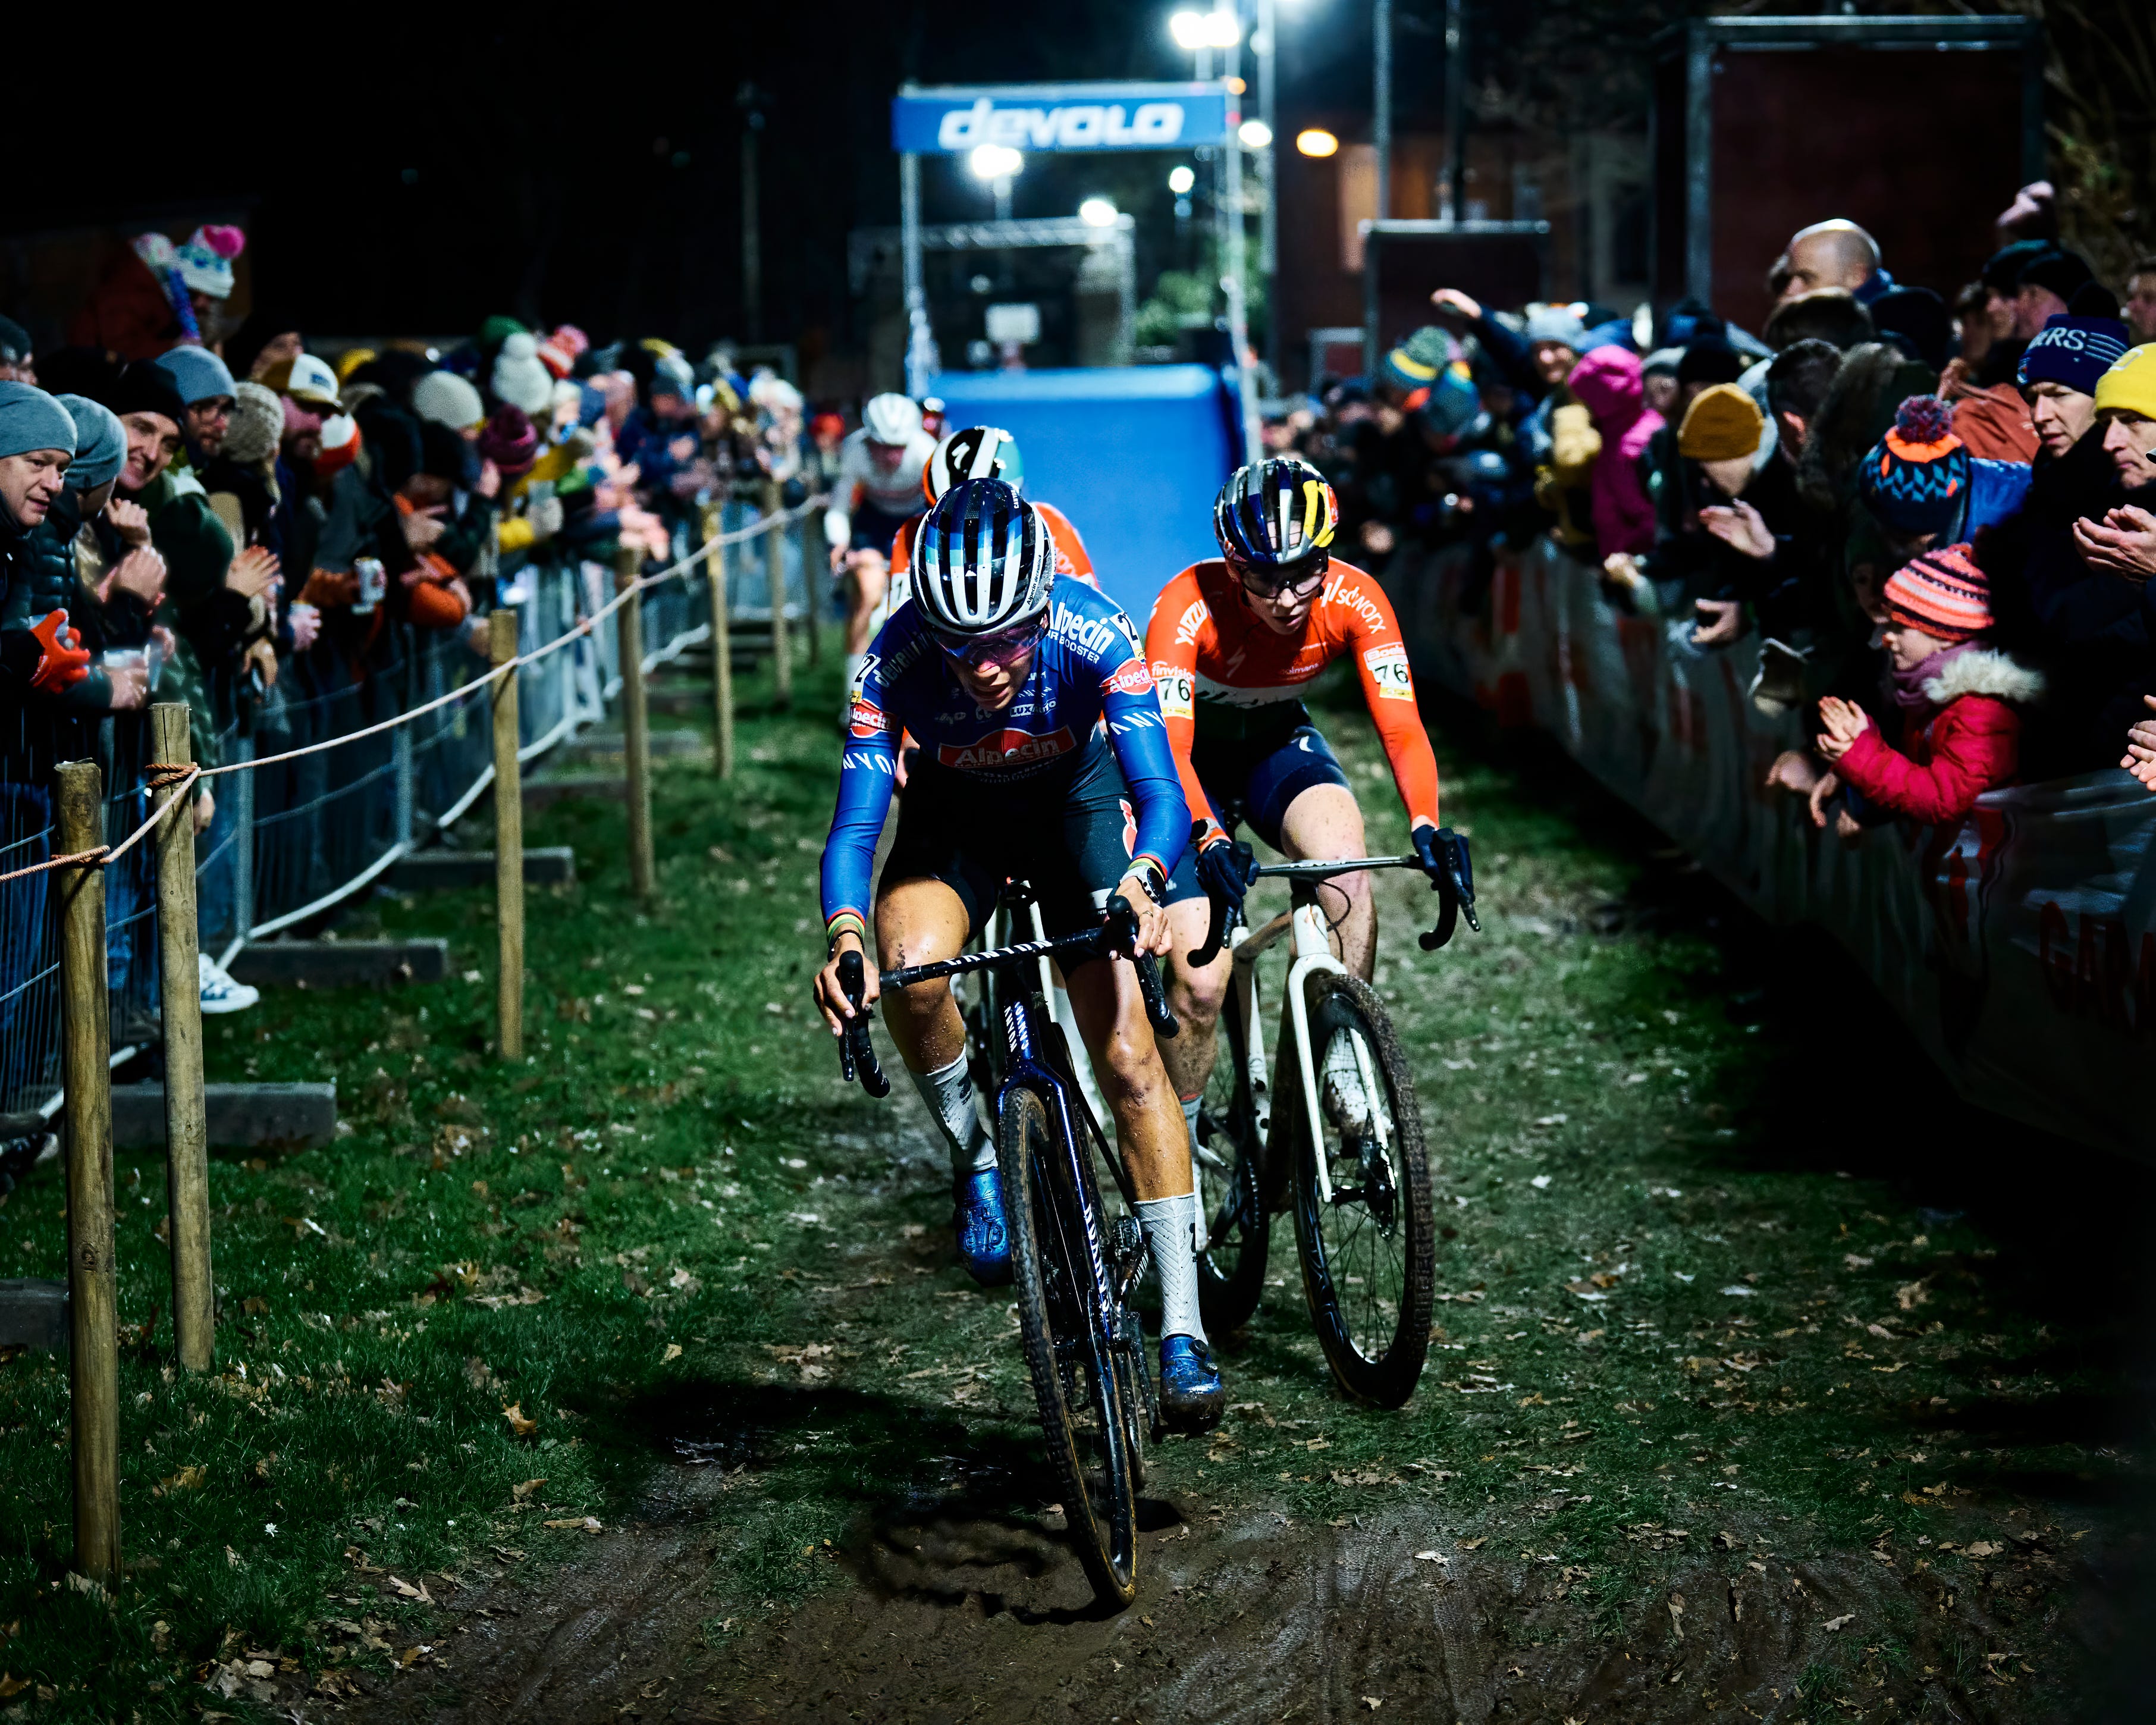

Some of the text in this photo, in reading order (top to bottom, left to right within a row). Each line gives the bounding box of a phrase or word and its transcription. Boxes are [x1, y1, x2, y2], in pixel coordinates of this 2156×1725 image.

[1027, 583, 1037, 606] Alpecin
[1059, 636, 1100, 664] BOOSTER
[1109, 665, 1151, 692] Alpeci
[1374, 664, 1408, 683] 76
[1159, 678, 1190, 702] 76
[1110, 711, 1166, 735] ANY
[953, 738, 1062, 766] Alpecin
[942, 939, 1053, 966] CANYON
[1004, 1005, 1018, 1053] ANYON
